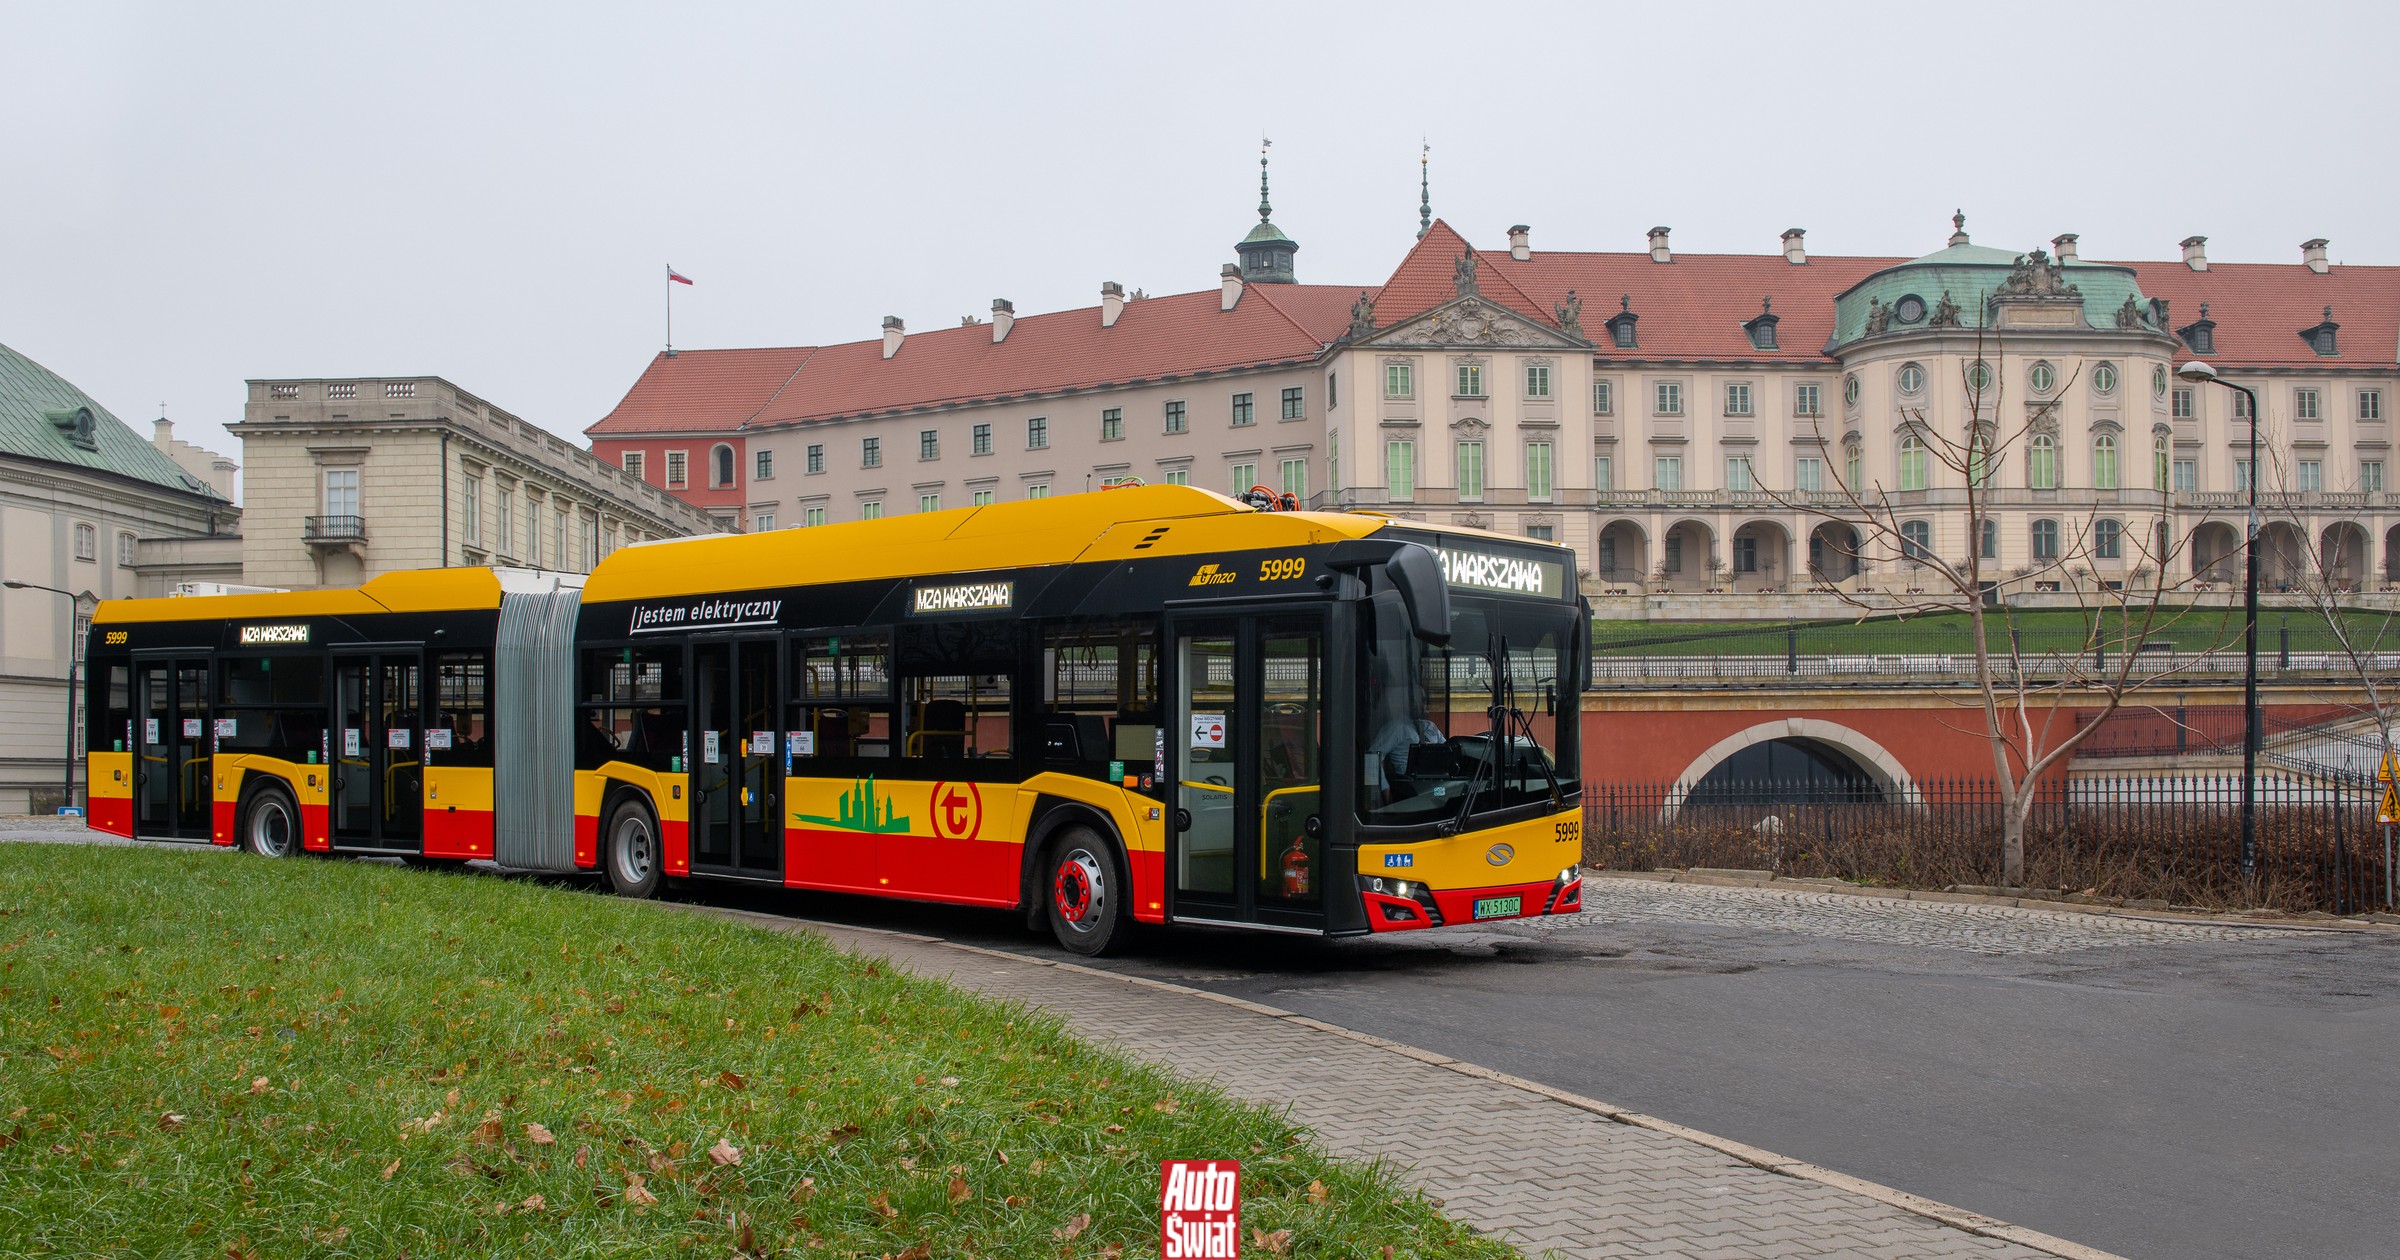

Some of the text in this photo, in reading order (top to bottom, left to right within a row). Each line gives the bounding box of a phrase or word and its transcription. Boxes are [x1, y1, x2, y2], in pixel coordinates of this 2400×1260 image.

[1259, 557, 1306, 582] 5999
[1452, 551, 1542, 593] WARSZAWA
[917, 584, 1009, 610] MZA WARSZAWA
[637, 600, 782, 629] jestem elektryczny
[105, 631, 128, 645] 5999
[242, 625, 308, 643] MZA WARSZAWA
[1555, 821, 1579, 843] 5999
[1480, 898, 1519, 915] WX 5130C
